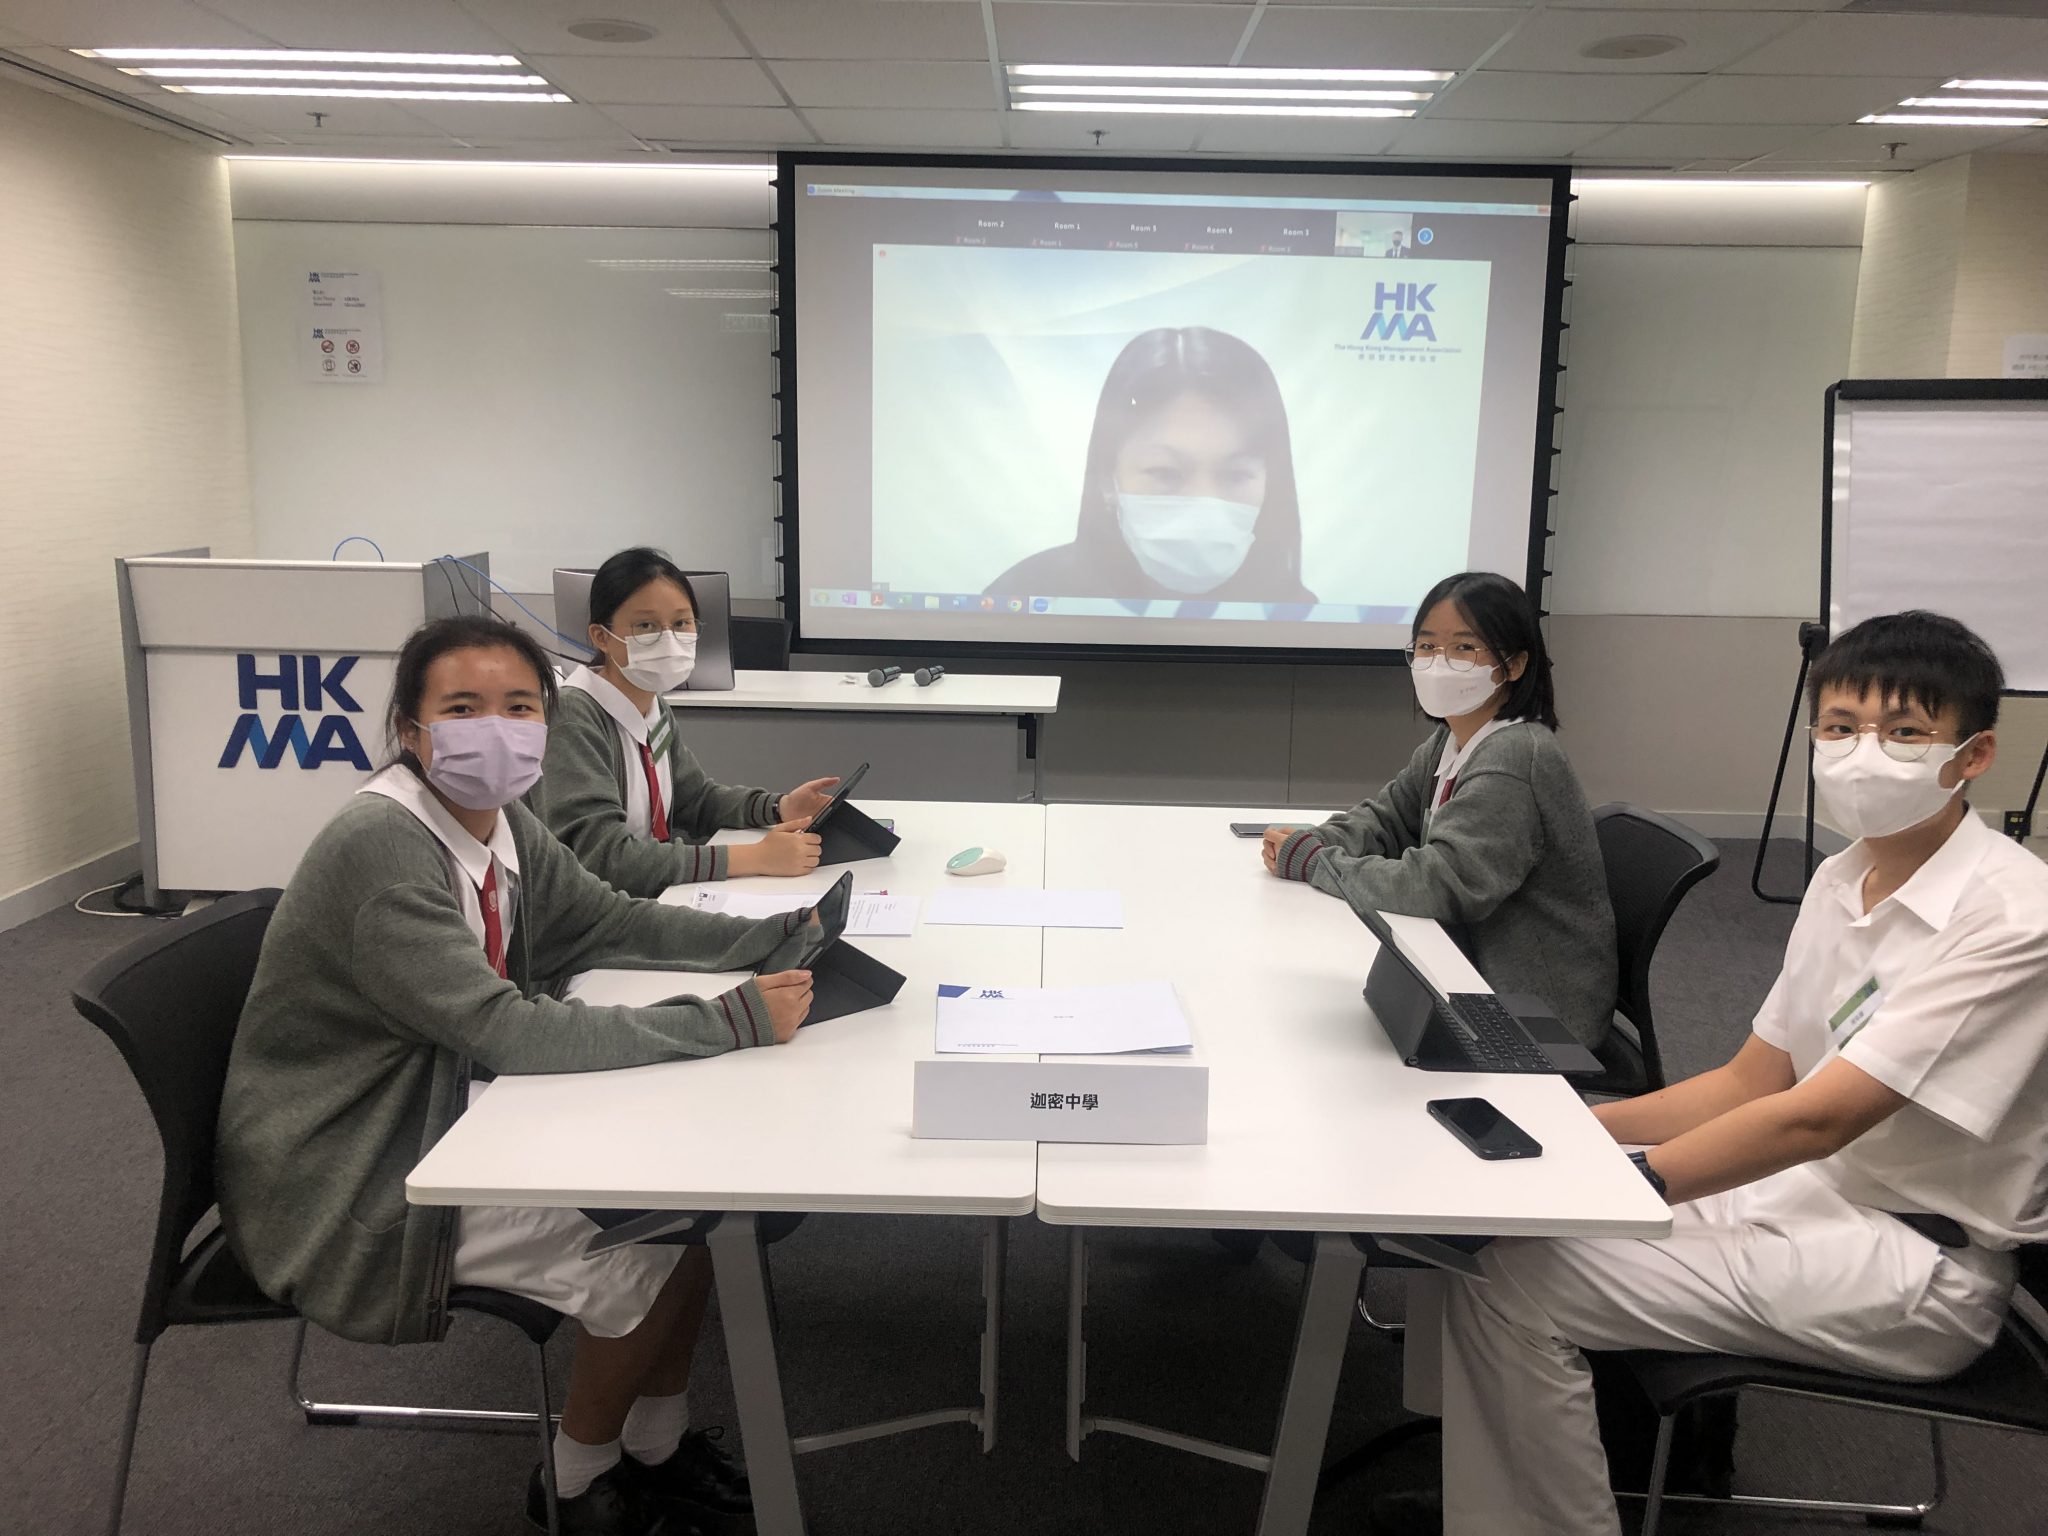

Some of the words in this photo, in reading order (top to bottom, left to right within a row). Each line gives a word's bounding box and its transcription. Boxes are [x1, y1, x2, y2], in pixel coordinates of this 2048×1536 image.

[978, 220, 998, 228] Room
[1054, 222, 1075, 230] Room
[1130, 224, 1151, 232] Room
[1206, 226, 1227, 234] Room
[1283, 228, 1303, 236] Room
[1374, 281, 1438, 312] HK
[237, 654, 364, 712] HK
[218, 714, 373, 771] MA
[1030, 1093, 1099, 1110] 迦密中學
